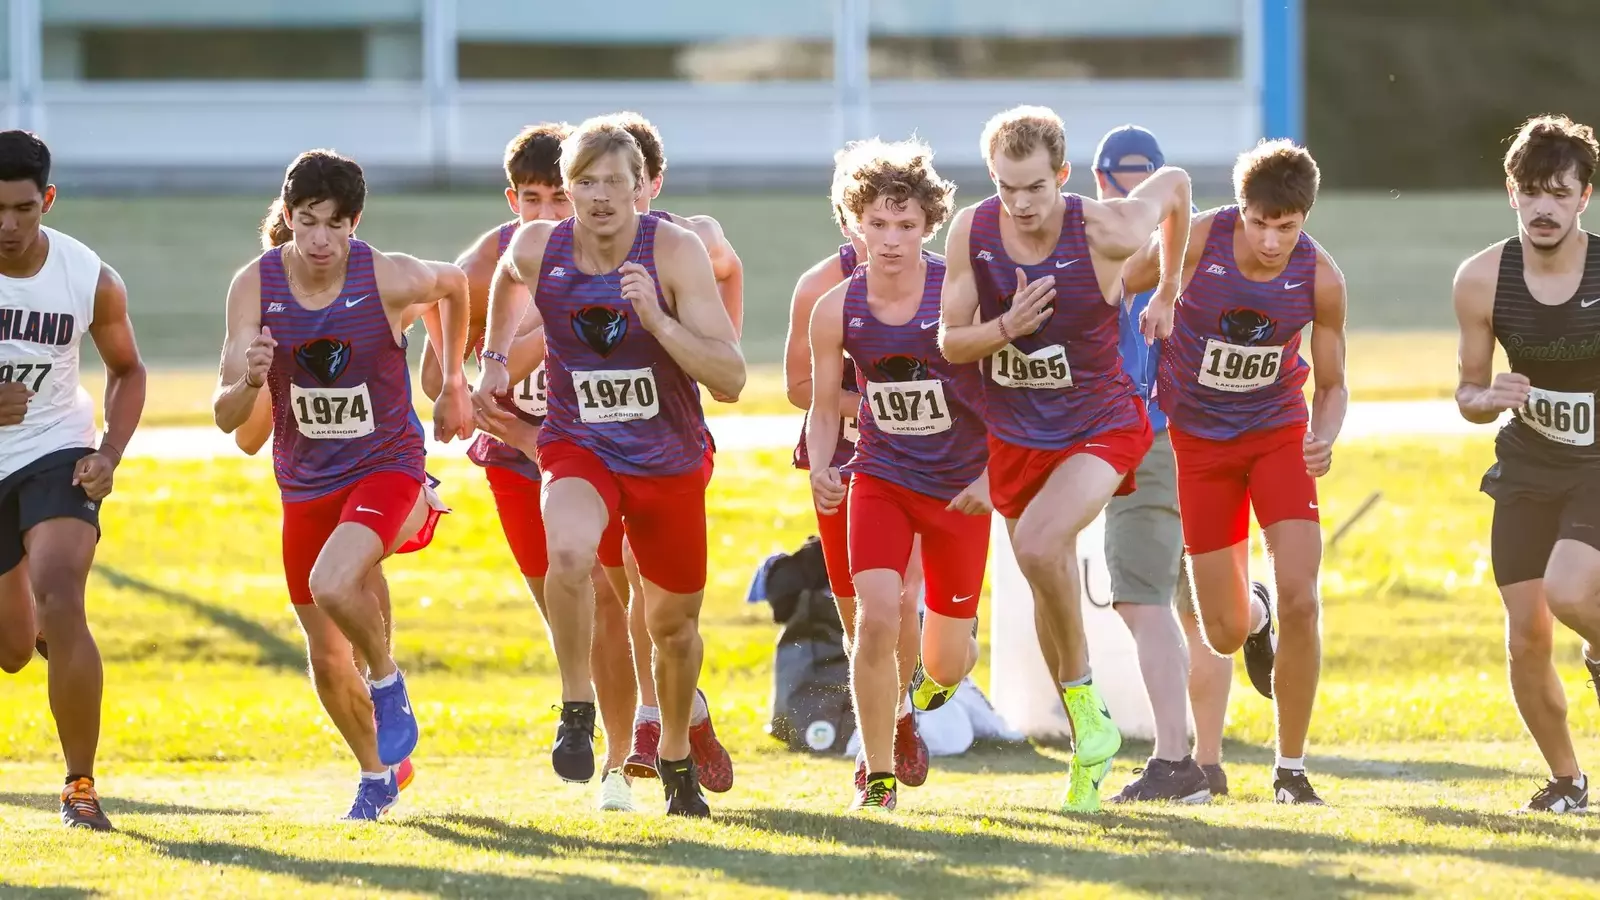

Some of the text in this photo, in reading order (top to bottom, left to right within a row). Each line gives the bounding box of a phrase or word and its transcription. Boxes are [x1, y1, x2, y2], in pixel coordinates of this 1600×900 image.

[997, 350, 1067, 380] 1965
[1206, 348, 1279, 380] 1966
[579, 377, 655, 408] 1970
[872, 389, 945, 422] 1971
[296, 393, 369, 425] 1974
[891, 424, 936, 432] LAKESHORE
